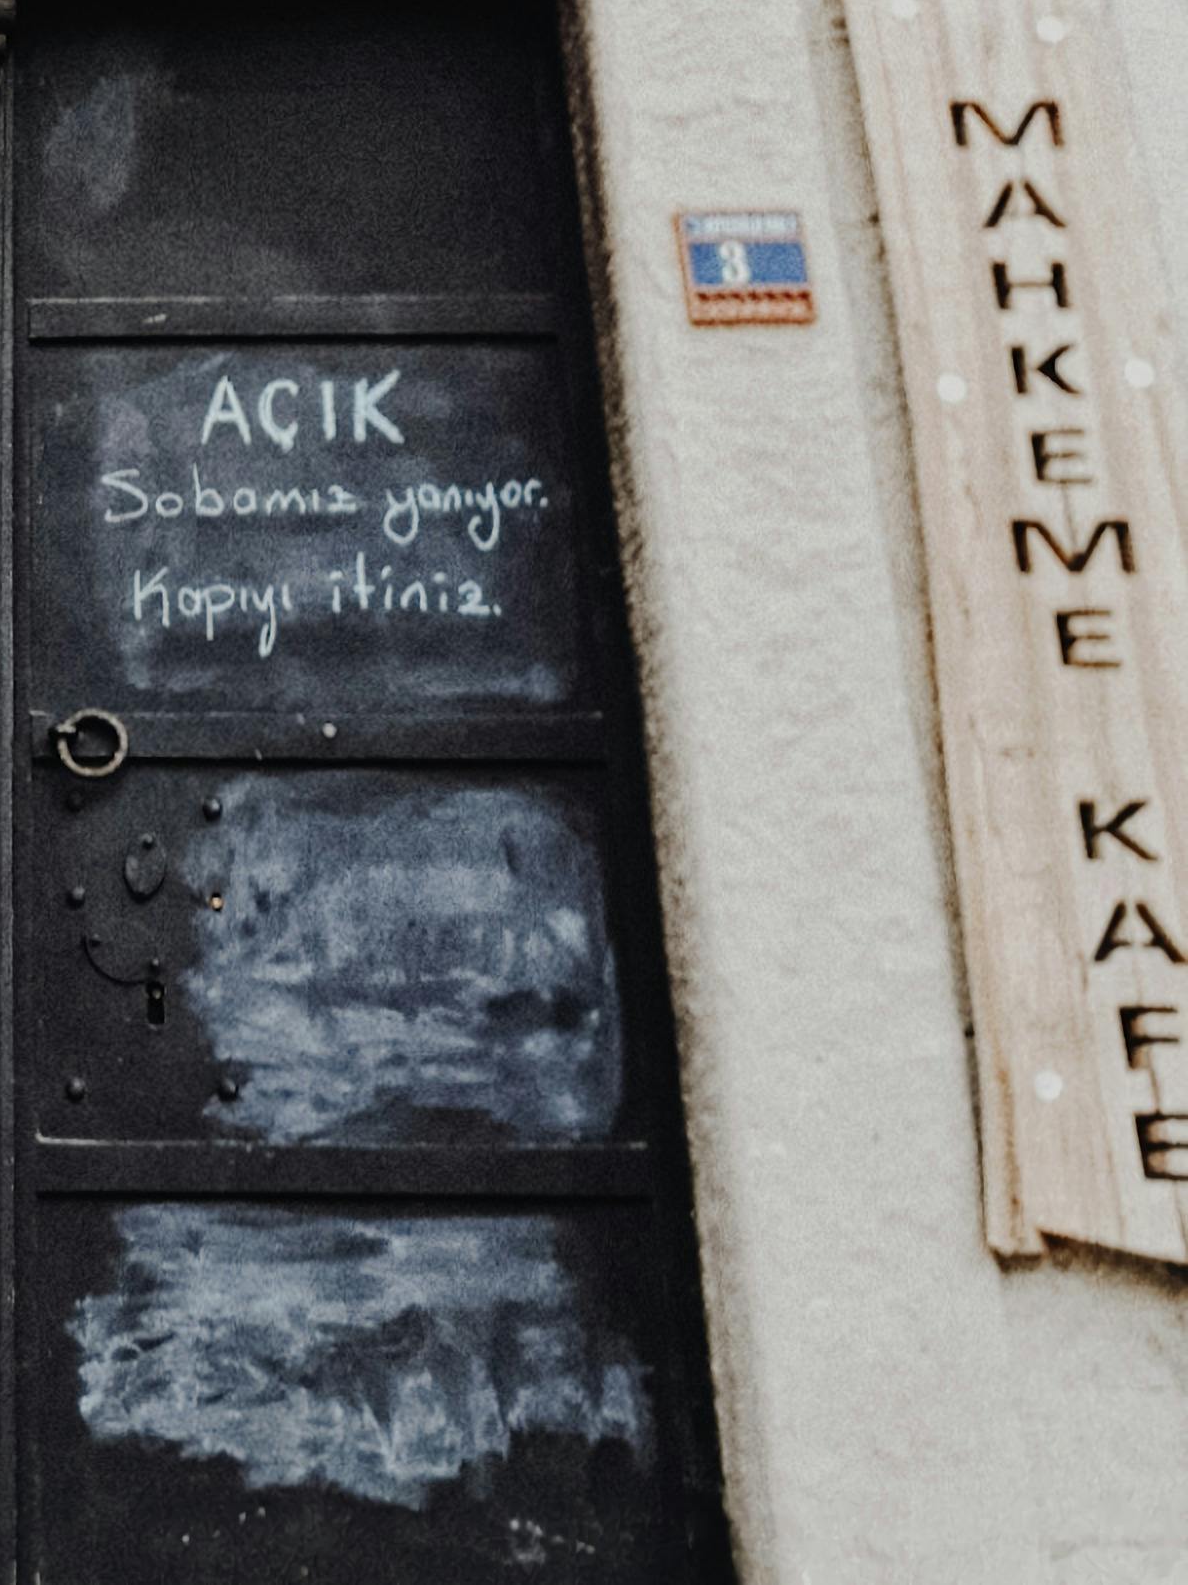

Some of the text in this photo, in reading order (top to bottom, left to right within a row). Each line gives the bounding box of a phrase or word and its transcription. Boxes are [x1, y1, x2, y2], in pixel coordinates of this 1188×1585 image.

[201, 369, 405, 453] AÇIK
[949, 100, 1137, 669] MAHKEME
[1077, 799, 1188, 1181] KAFE
